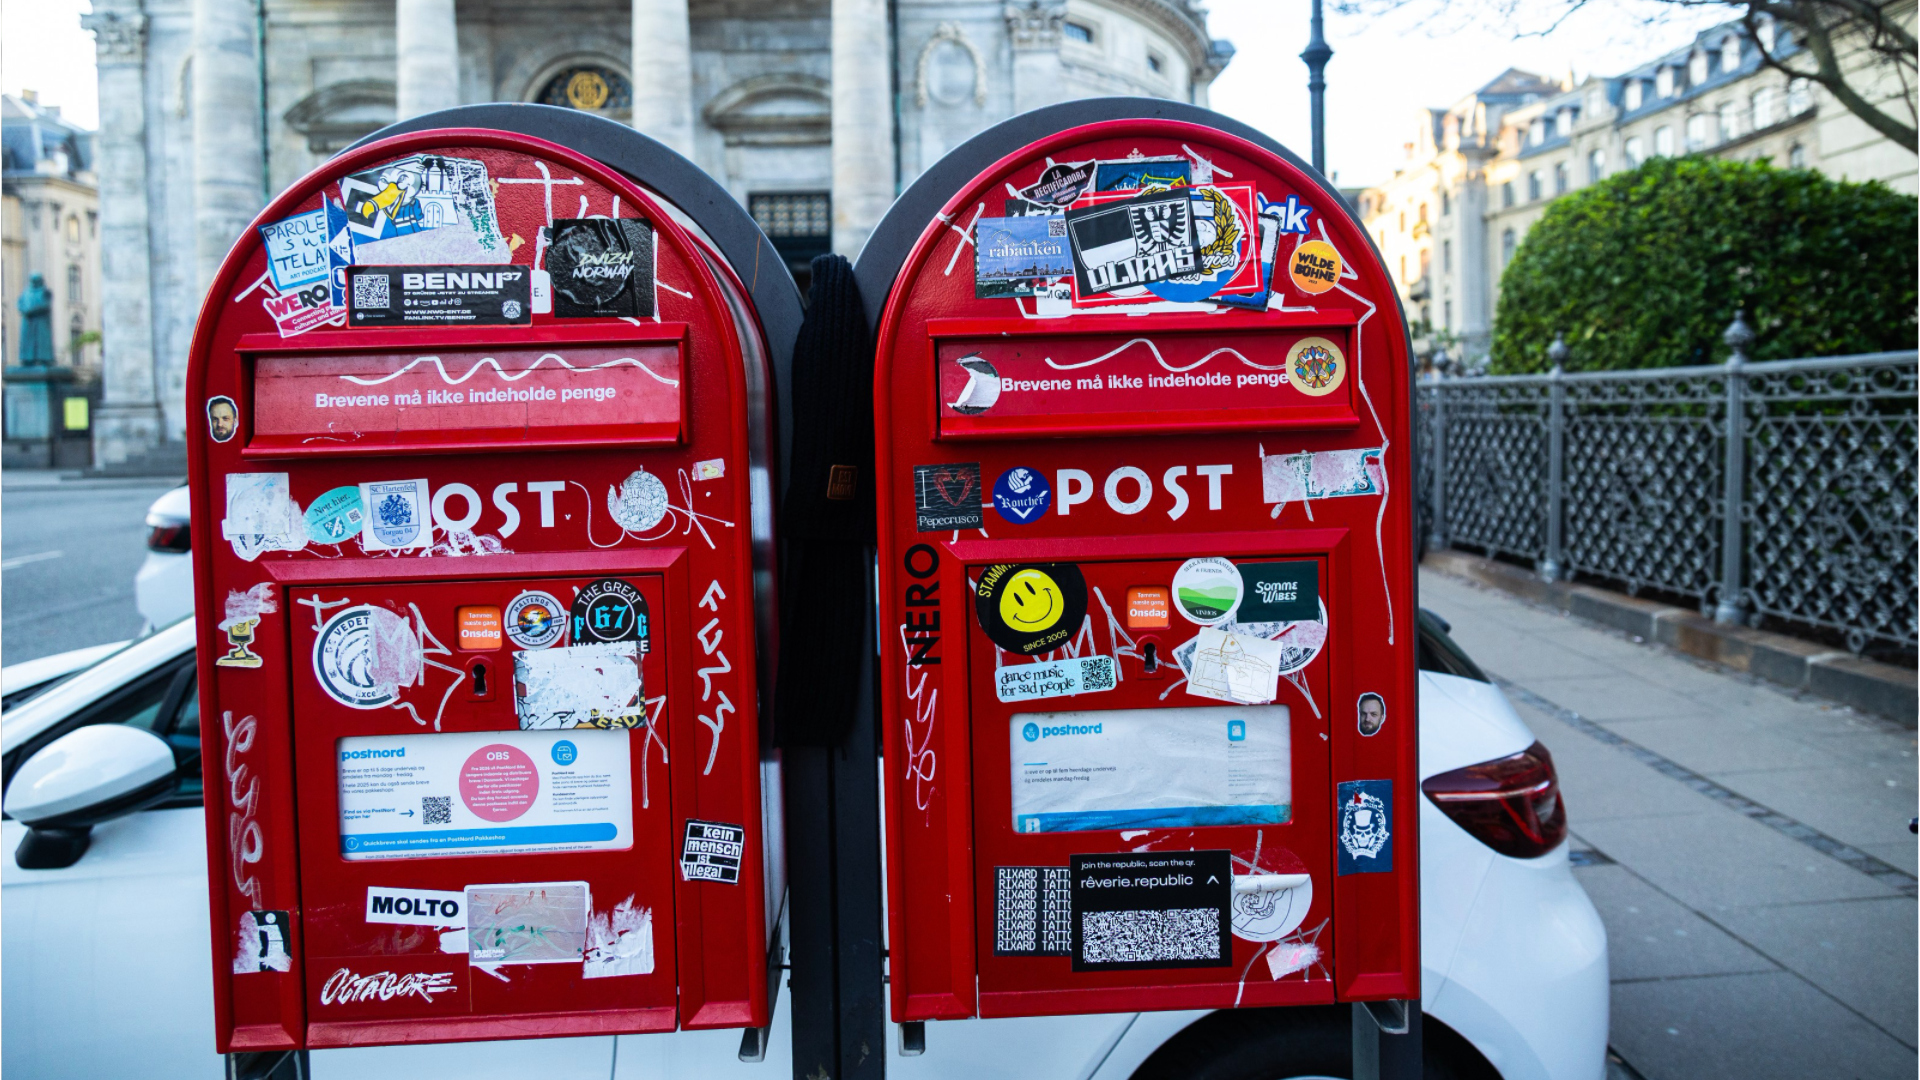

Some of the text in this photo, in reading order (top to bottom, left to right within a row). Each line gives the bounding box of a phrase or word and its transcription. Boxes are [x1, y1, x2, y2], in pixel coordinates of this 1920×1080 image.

[1052, 170, 1062, 180] LA
[1034, 170, 1086, 198] RECTIFICADORA
[264, 215, 326, 242] PAROLE
[989, 243, 1062, 258] rabauken
[275, 249, 325, 271] TELA
[1087, 246, 1195, 289] ULTRAS
[1298, 252, 1336, 270] WILDE
[302, 266, 327, 277] PODCAST
[572, 264, 634, 279] NORWAY
[266, 284, 330, 319] WERO
[292, 308, 326, 325] Connecting
[318, 312, 330, 321] and
[1002, 372, 1289, 392] Brevene må ikke indeholde penge
[315, 386, 616, 408] Brevene må ikke indeholde penge
[382, 484, 416, 492] Hartenfels
[1056, 464, 1232, 521] POST
[314, 492, 351, 516] Nett hier.
[381, 528, 404, 537] Torgau
[578, 581, 643, 606] THE GREAT
[904, 543, 942, 666] NERO
[1130, 608, 1167, 618] Onsdag
[574, 615, 584, 641] F
[594, 604, 628, 629] 67
[461, 629, 501, 639] Onsdag
[1023, 629, 1068, 652] SINCE 2005
[1001, 665, 1064, 685] dance music
[1001, 677, 1076, 697] for sad people
[1042, 723, 1102, 738] postnord
[342, 747, 405, 762] postnord
[486, 751, 510, 761] OBS
[702, 825, 735, 841] kein
[688, 840, 739, 856] mensch
[698, 854, 711, 864] ist
[1081, 862, 1096, 870] join
[1112, 860, 1148, 869] republic,
[686, 863, 722, 878] illegal
[999, 869, 1070, 878] RIXARD TATT
[999, 879, 1070, 889] RIXARD TATT
[1081, 874, 1193, 889] rêverie.republic
[999, 890, 1037, 899] RIXARD
[372, 896, 459, 918] MOLTO
[998, 900, 1036, 909] RIXARD
[998, 910, 1036, 920] RIXARD
[998, 920, 1036, 930] RIXARD
[998, 931, 1036, 940] RIXARD
[998, 941, 1036, 950] RIXARD
[320, 968, 457, 1006] OCTAGORE
